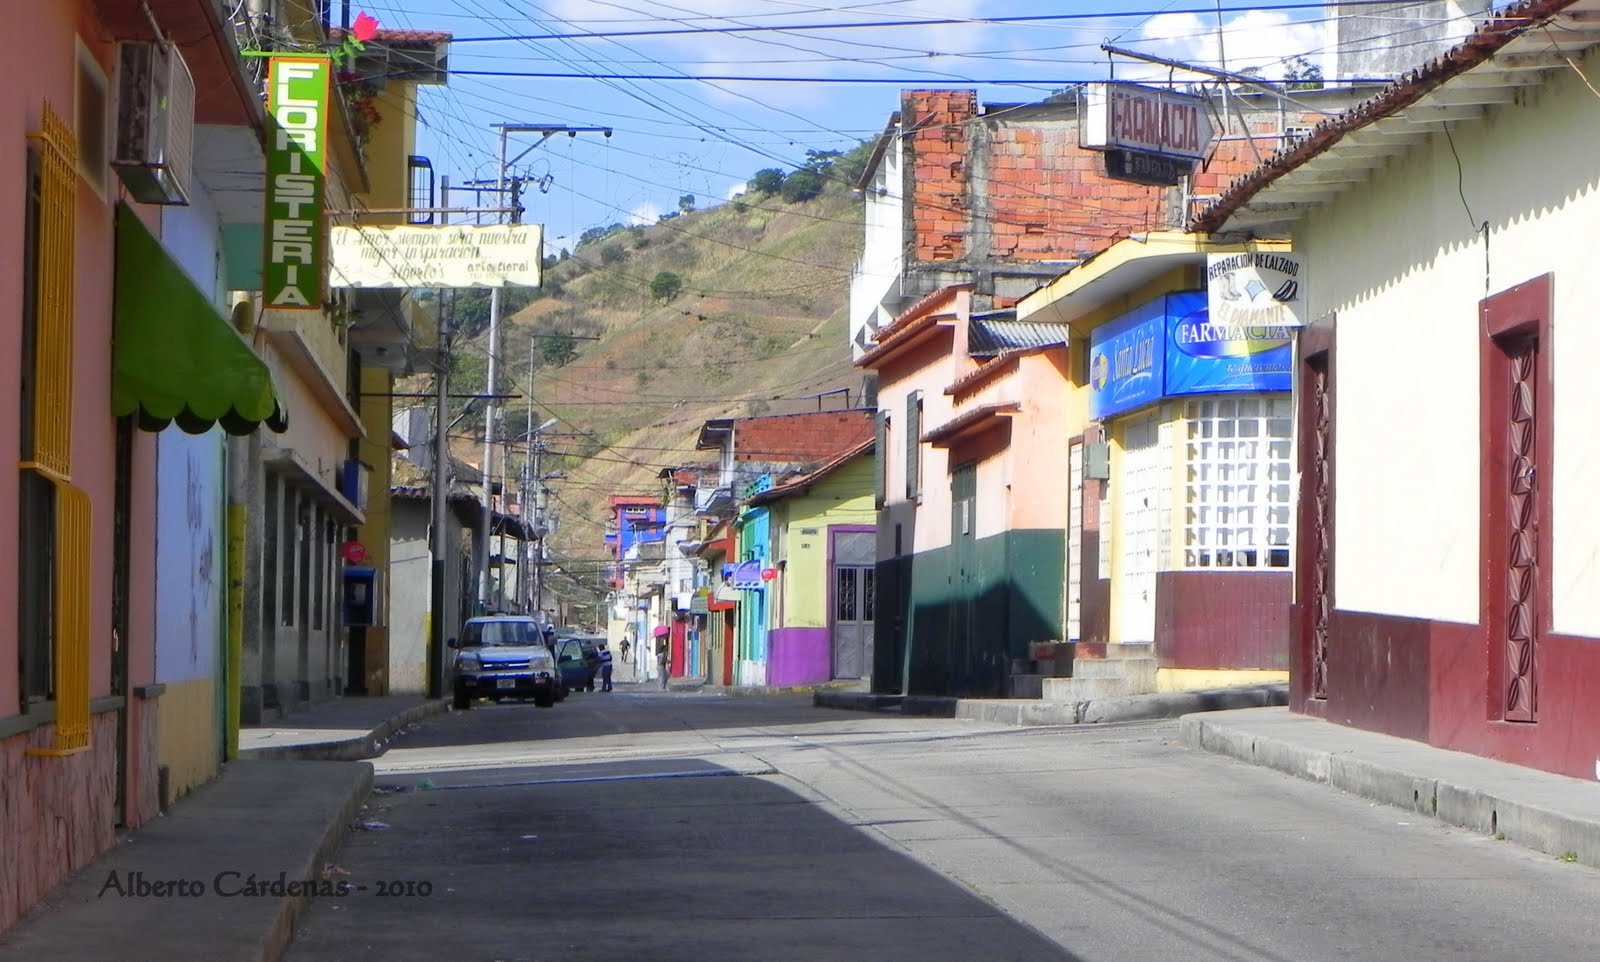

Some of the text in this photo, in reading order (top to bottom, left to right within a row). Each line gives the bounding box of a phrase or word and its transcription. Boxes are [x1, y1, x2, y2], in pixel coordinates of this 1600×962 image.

[1111, 91, 1199, 151] FARMACIA
[271, 61, 320, 306] FLORISTERIA
[396, 232, 442, 247] siempre
[479, 228, 528, 245] nuestra
[360, 246, 397, 268] mejor
[1264, 254, 1300, 277] CALZADO
[1180, 323, 1292, 345] FARMACIA
